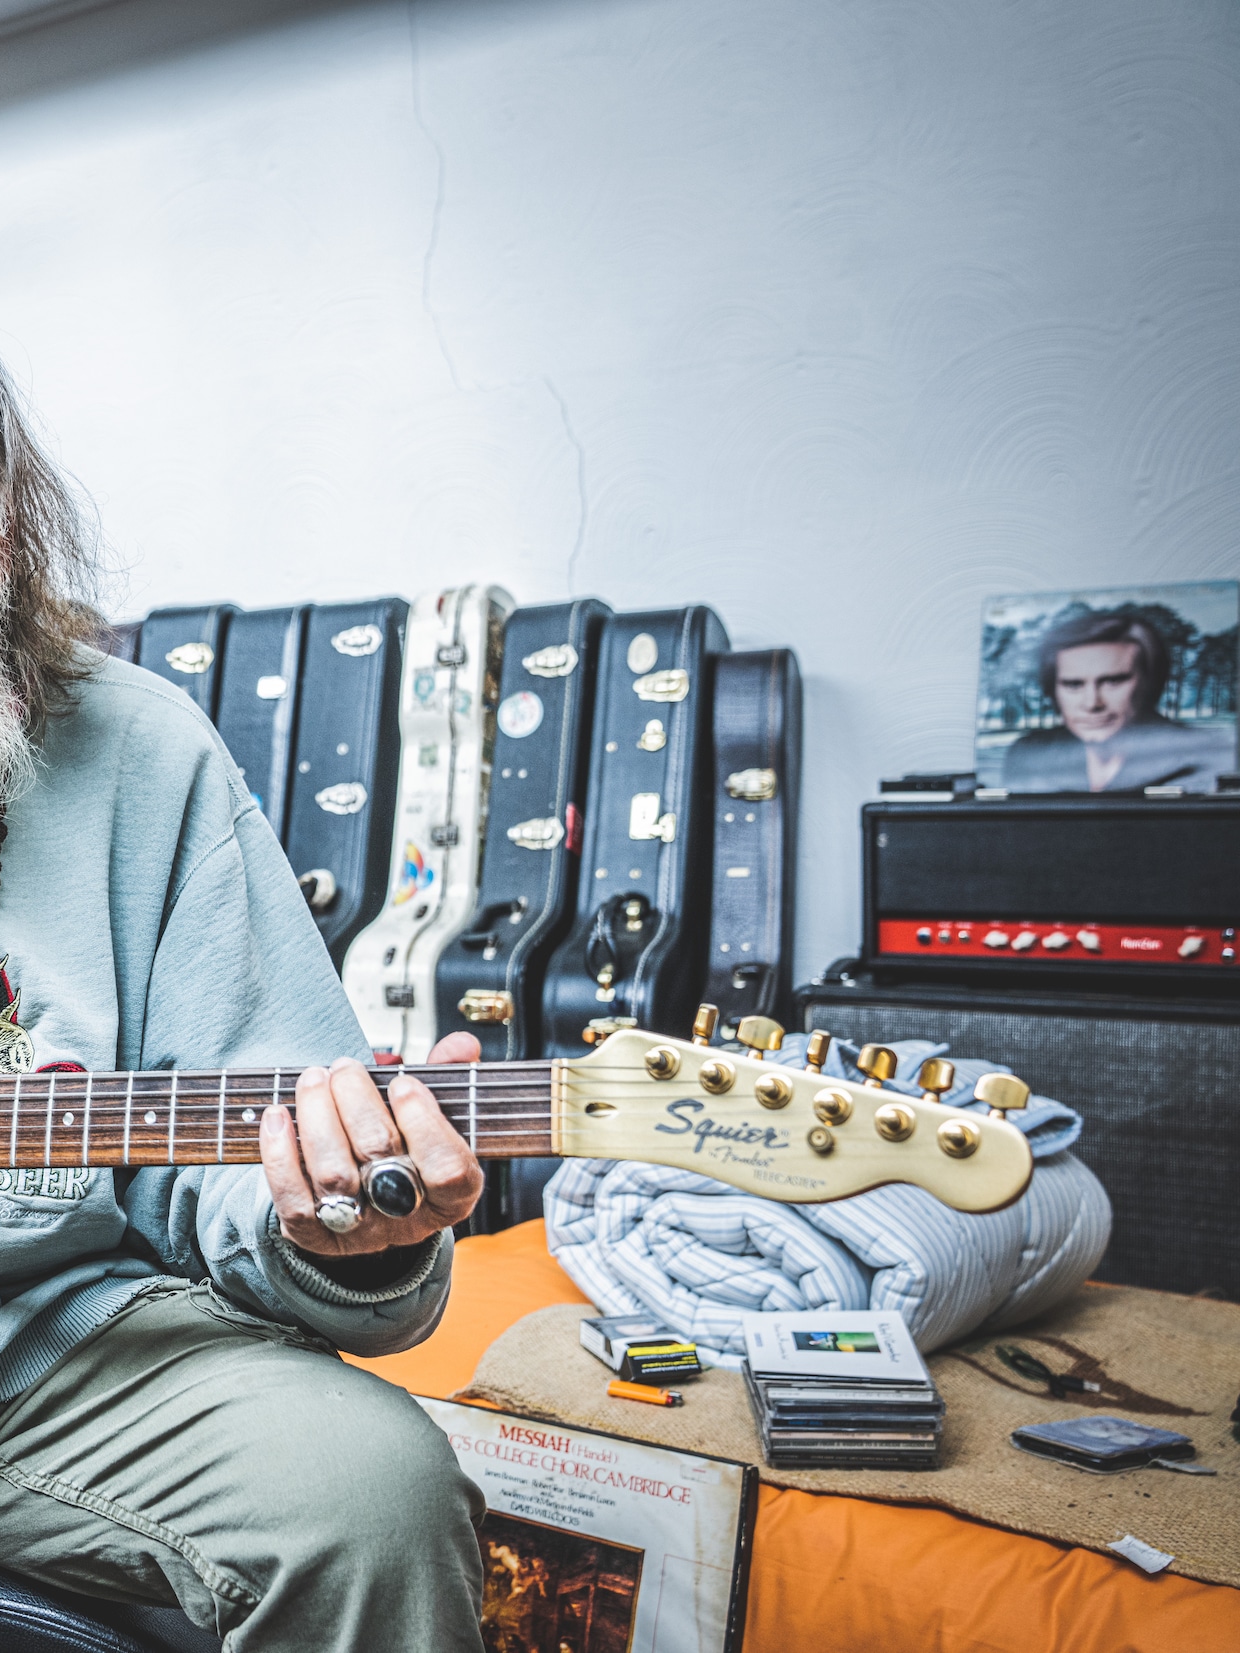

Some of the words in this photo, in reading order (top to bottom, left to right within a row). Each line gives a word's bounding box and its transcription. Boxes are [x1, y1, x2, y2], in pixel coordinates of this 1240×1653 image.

[655, 1098, 788, 1153] Squier
[499, 1423, 571, 1454] MESSIAH
[474, 1438, 539, 1469] COLLEGE
[593, 1470, 692, 1505] CAMBRIDGE
